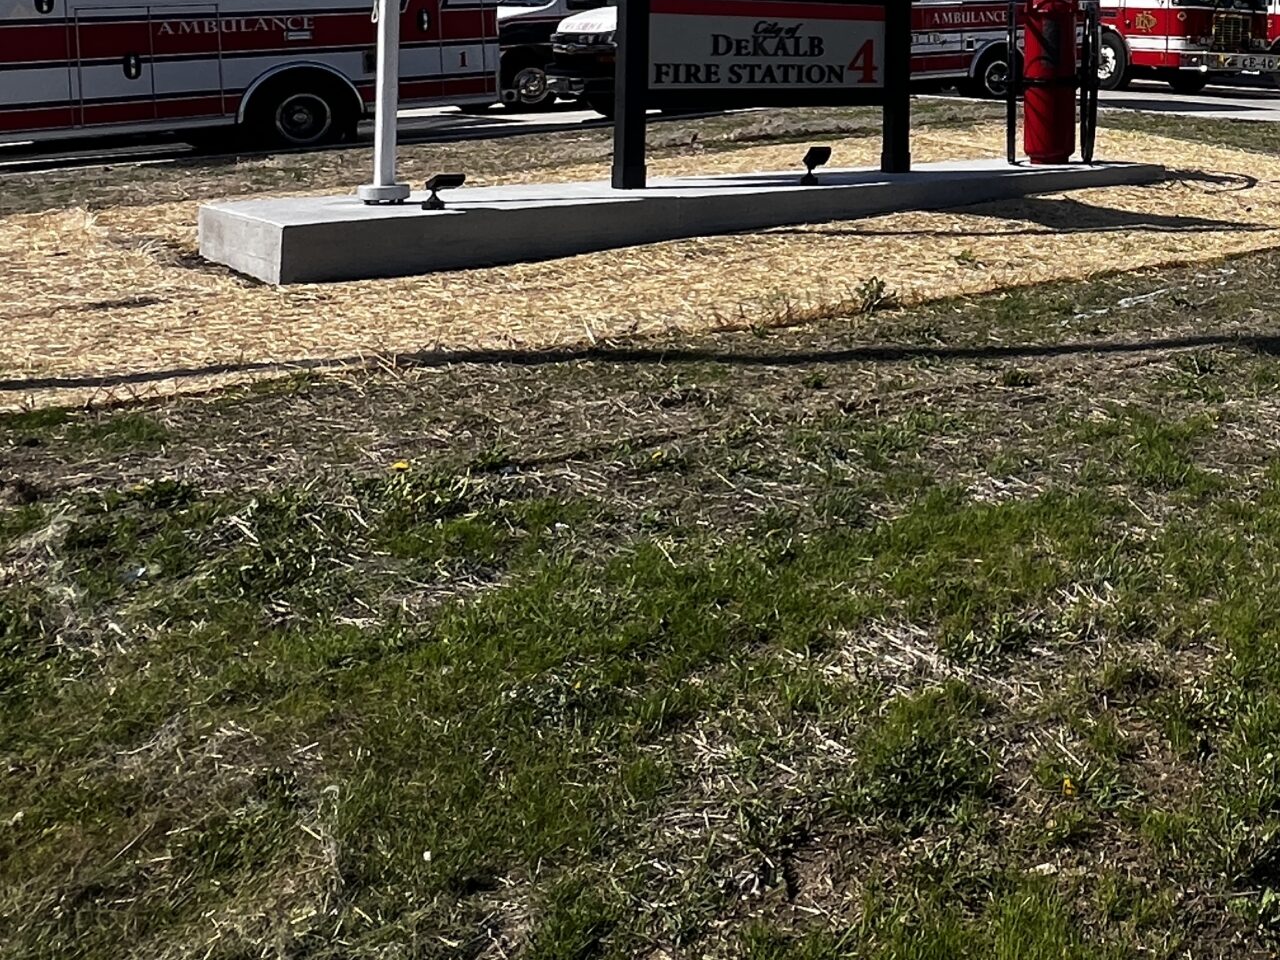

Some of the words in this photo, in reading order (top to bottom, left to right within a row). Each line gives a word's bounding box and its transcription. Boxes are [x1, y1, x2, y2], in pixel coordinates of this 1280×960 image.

[157, 16, 315, 36] AMBULANCE
[932, 10, 1008, 25] AMBULANCE
[753, 20, 783, 36] City
[785, 23, 804, 38] of
[458, 50, 468, 67] 1
[653, 63, 720, 84] FIRE
[728, 63, 845, 84] STATION
[847, 39, 878, 84] 4
